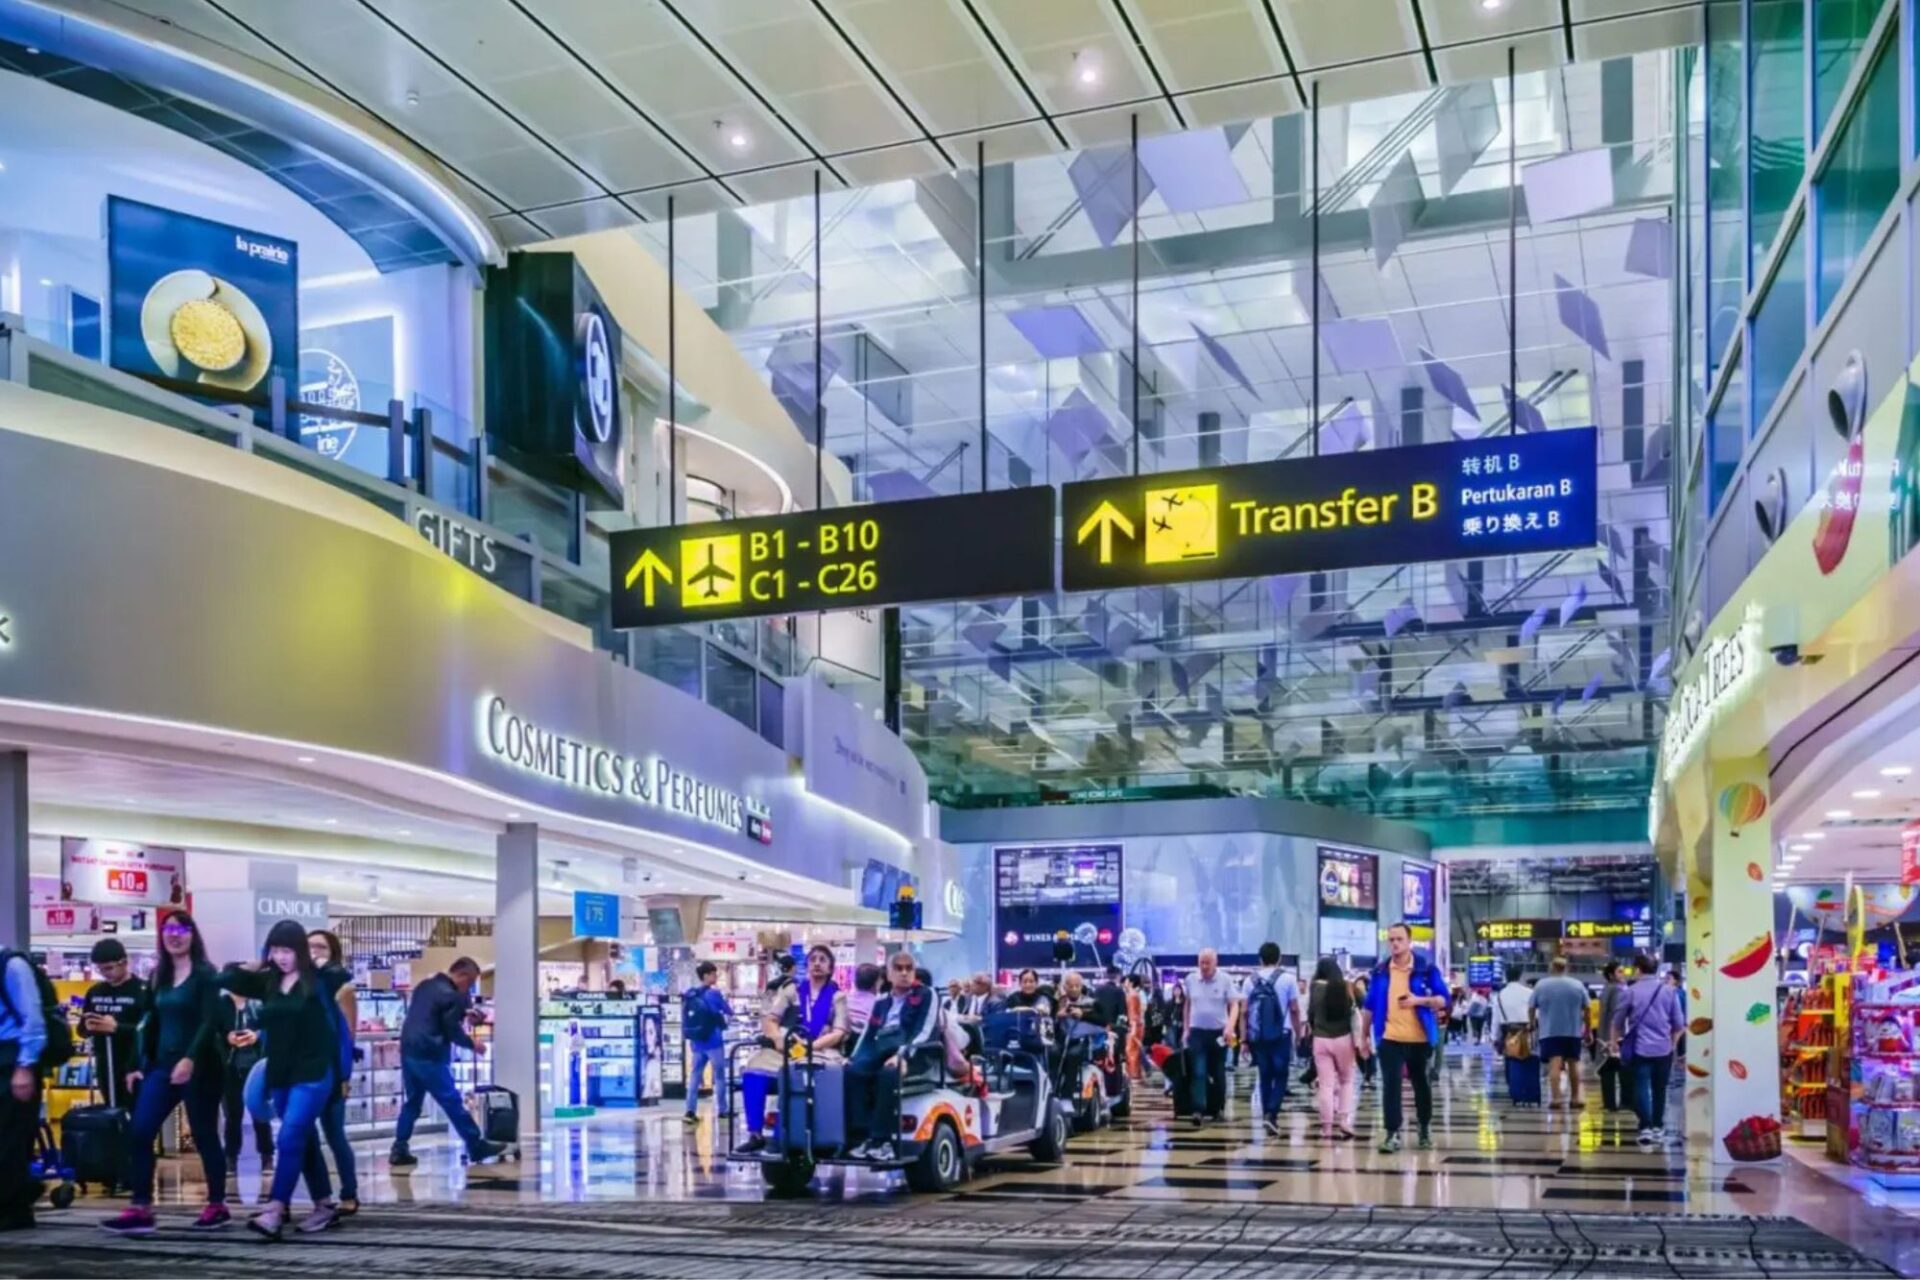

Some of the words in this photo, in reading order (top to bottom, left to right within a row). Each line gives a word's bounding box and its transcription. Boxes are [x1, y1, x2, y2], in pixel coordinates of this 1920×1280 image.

[236, 234, 248, 251] la
[249, 243, 289, 261] prairie
[1508, 453, 1520, 471] B
[1230, 487, 1399, 535] Transfer
[1411, 483, 1438, 520] B
[1461, 483, 1556, 506] Pertukaran
[1560, 478, 1572, 496] B
[1548, 510, 1560, 528] B
[416, 508, 497, 573] GIFTS
[750, 529, 785, 561] B1
[820, 519, 879, 555] B10
[749, 569, 785, 600] C1
[818, 560, 878, 594] C26
[487, 696, 624, 795] COSMETICS
[631, 760, 652, 801] &
[656, 760, 744, 832] PERFUMES
[257, 897, 325, 918] CLINIQUE
